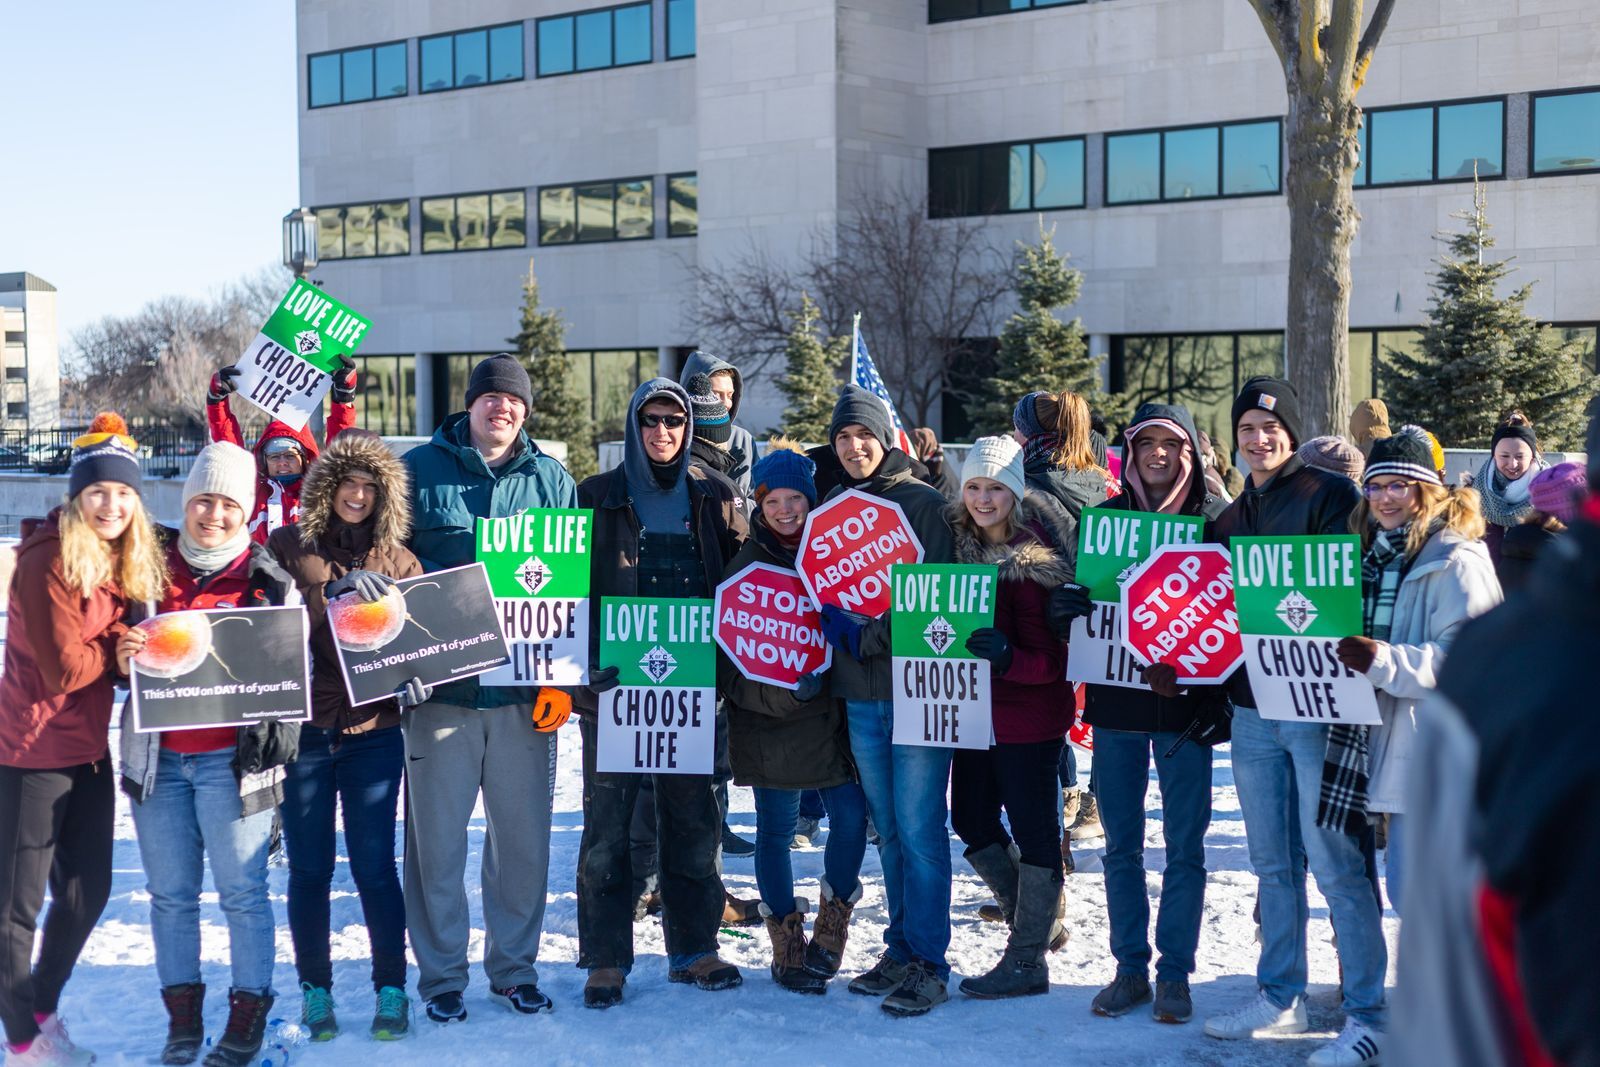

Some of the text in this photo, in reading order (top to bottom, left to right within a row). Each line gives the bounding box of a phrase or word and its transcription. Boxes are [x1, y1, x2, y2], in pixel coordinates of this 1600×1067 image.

[284, 284, 367, 348] LOVE LIFE
[255, 341, 325, 398] CHOOSE
[250, 376, 292, 414] LIFE
[482, 515, 587, 553] LOVE LIFE
[810, 506, 879, 560] STOP
[1084, 515, 1198, 558] LOVE LIFE
[814, 526, 909, 594] ABORTION
[1236, 543, 1355, 588] LOVE LIFE
[738, 582, 815, 616] STOP
[895, 574, 992, 614] LOVE LIFE
[1133, 555, 1201, 631] STOP
[496, 601, 575, 638] HOOSE
[606, 603, 711, 643] LOVE LIFE
[721, 607, 825, 649] ABORTION
[1146, 565, 1234, 663] ABORTION
[352, 632, 498, 674] This is YOU on DAY 1 of your life.
[513, 644, 553, 680] LIFE
[736, 635, 809, 672] NOW
[1106, 645, 1148, 685] LIF
[1258, 638, 1355, 678] CHOOS
[142, 680, 300, 699] This is YOU on DAY 1 of your life.
[904, 660, 978, 701] CHOOSE
[1288, 681, 1341, 718] LIFE
[613, 689, 701, 728] CHOOSE
[923, 704, 959, 743] LIFE
[635, 731, 677, 769] LIFE
